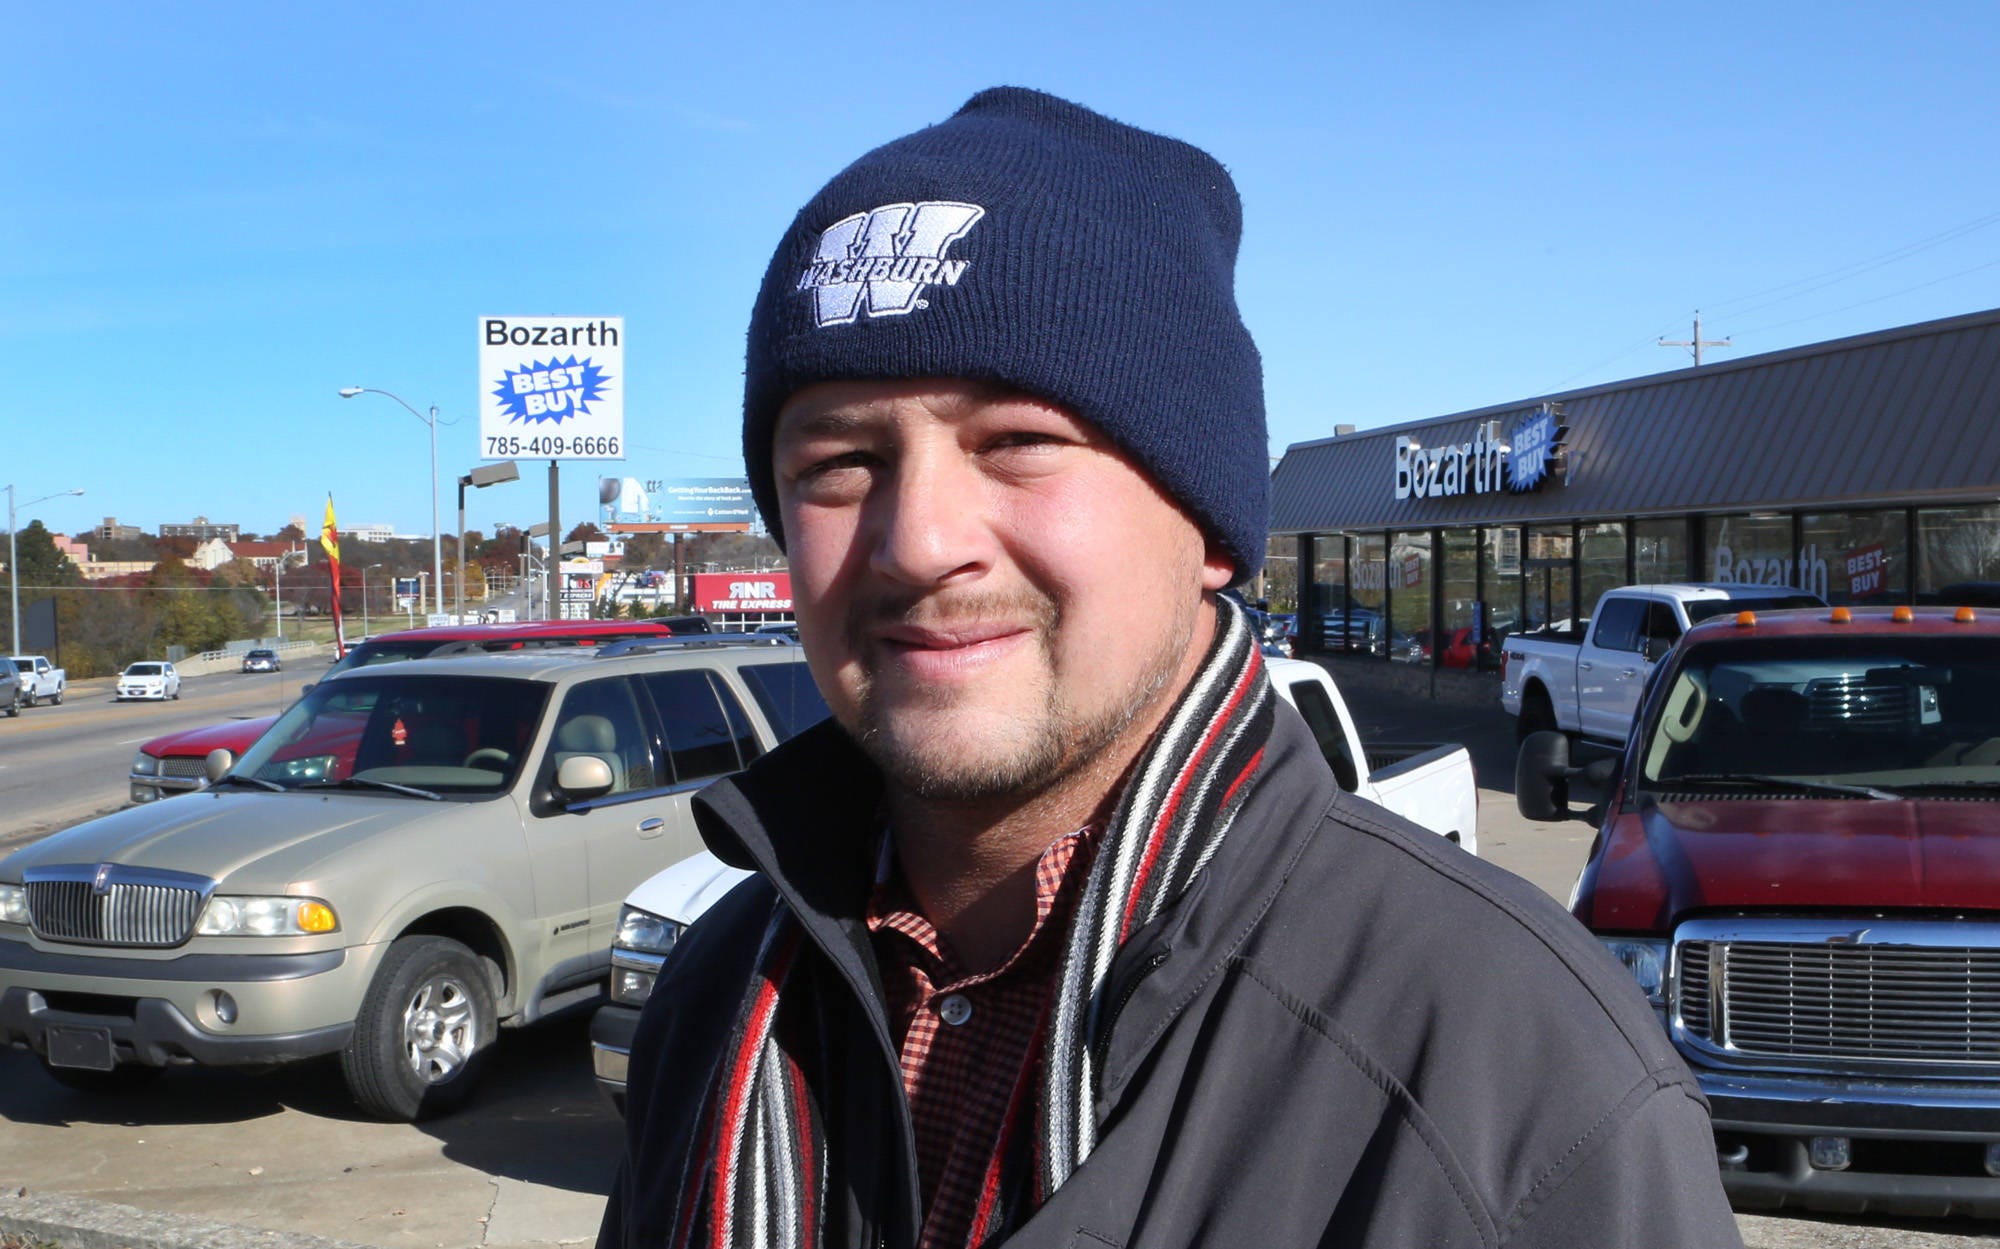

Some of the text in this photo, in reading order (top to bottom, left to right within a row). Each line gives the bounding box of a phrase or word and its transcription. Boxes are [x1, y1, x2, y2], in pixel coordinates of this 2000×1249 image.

[796, 256, 970, 291] WASHBURN
[485, 320, 618, 346] Bozarth
[512, 365, 585, 394] BEST
[524, 387, 585, 416] BUY
[487, 436, 619, 455] 785-409-6666
[1514, 416, 1549, 457] BEST
[1395, 420, 1500, 500] Bozarth
[1518, 445, 1546, 481] BUY
[1847, 549, 1882, 576] BEST
[1851, 571, 1880, 594] BUY
[712, 600, 792, 609] TIRE EXPRESS
